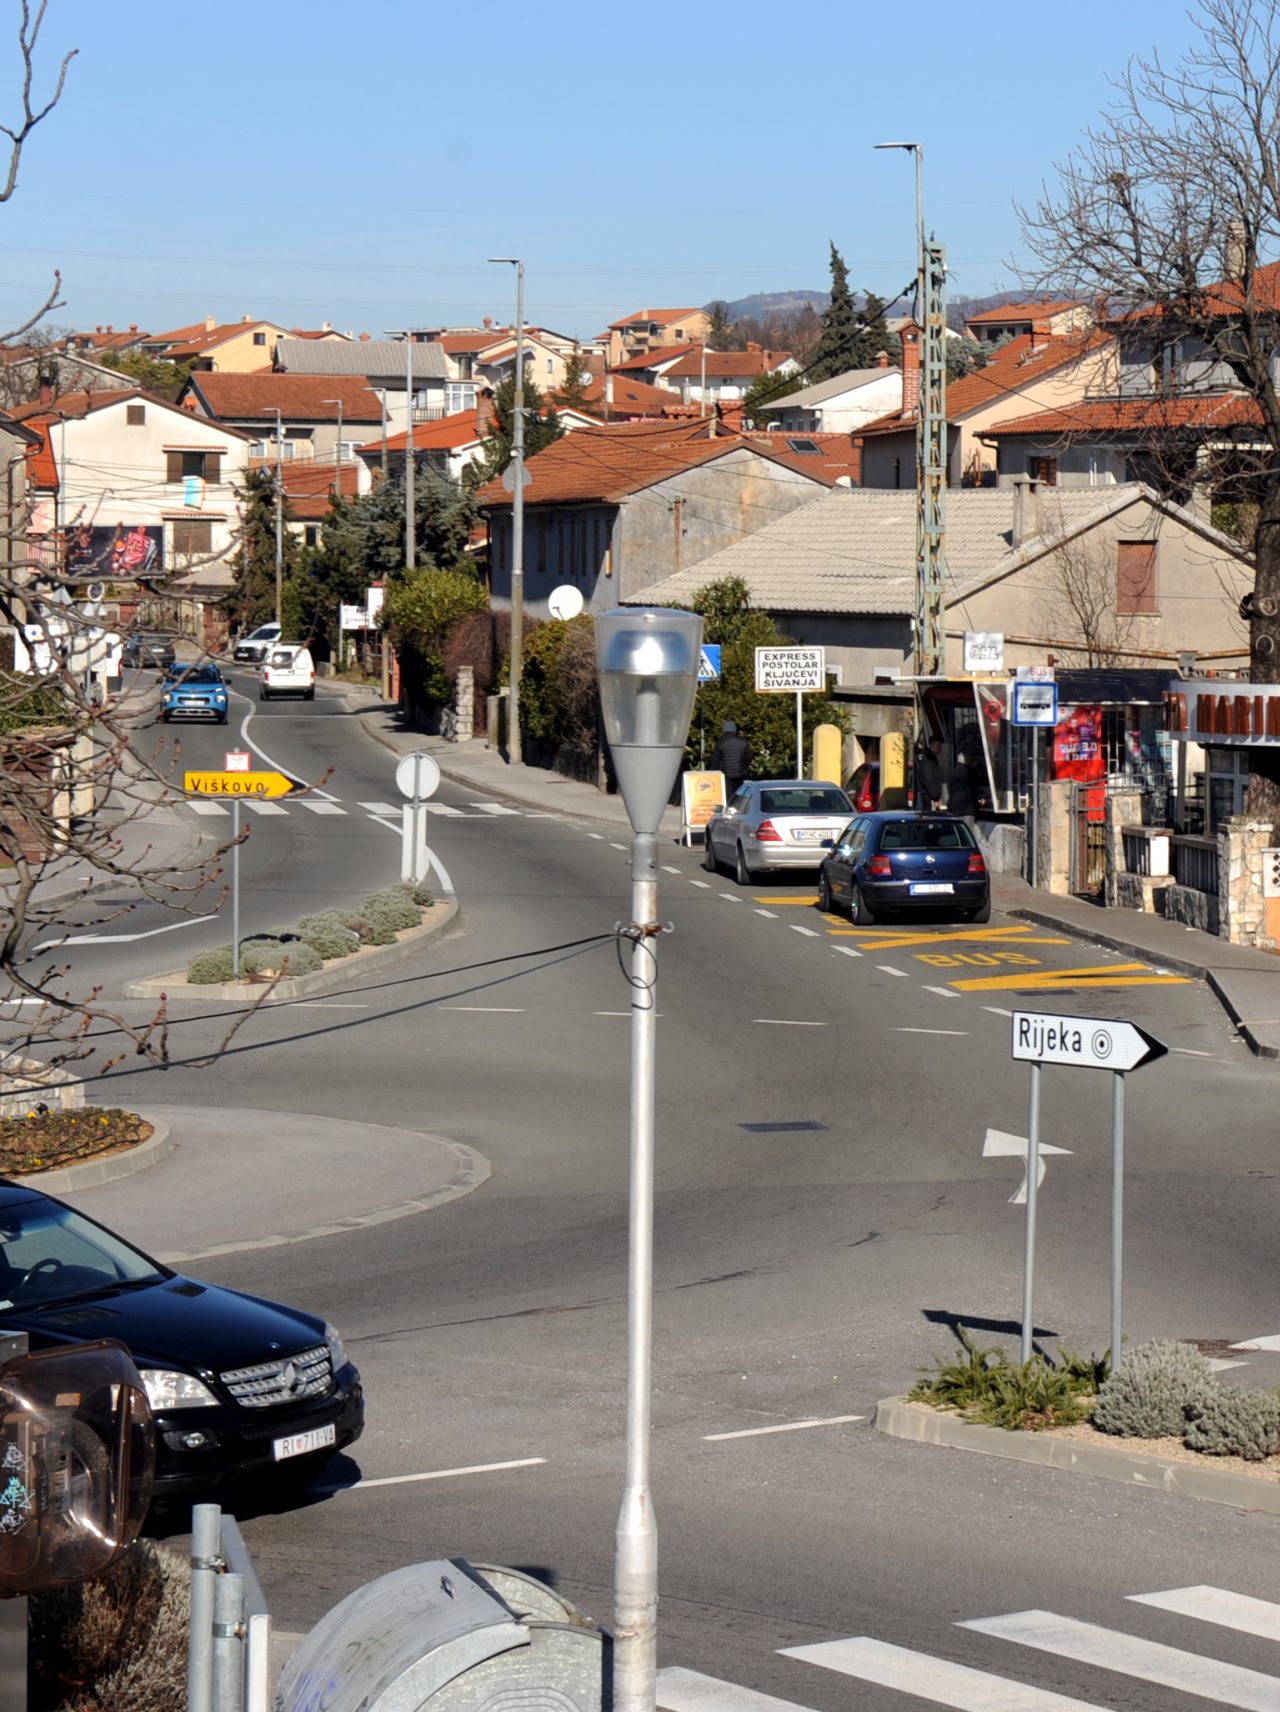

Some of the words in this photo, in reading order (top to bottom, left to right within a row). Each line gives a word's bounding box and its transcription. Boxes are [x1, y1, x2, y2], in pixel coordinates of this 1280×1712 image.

[764, 652, 816, 661] EXPRESS
[762, 661, 818, 669] POSTOLAR
[764, 670, 818, 679] KLJUČEVI
[1030, 667, 1048, 677] BUS
[190, 778, 264, 792] Viškovo
[912, 952, 1042, 967] BUS
[1018, 1016, 1082, 1057] Rijeka
[282, 1439, 295, 1456] RI
